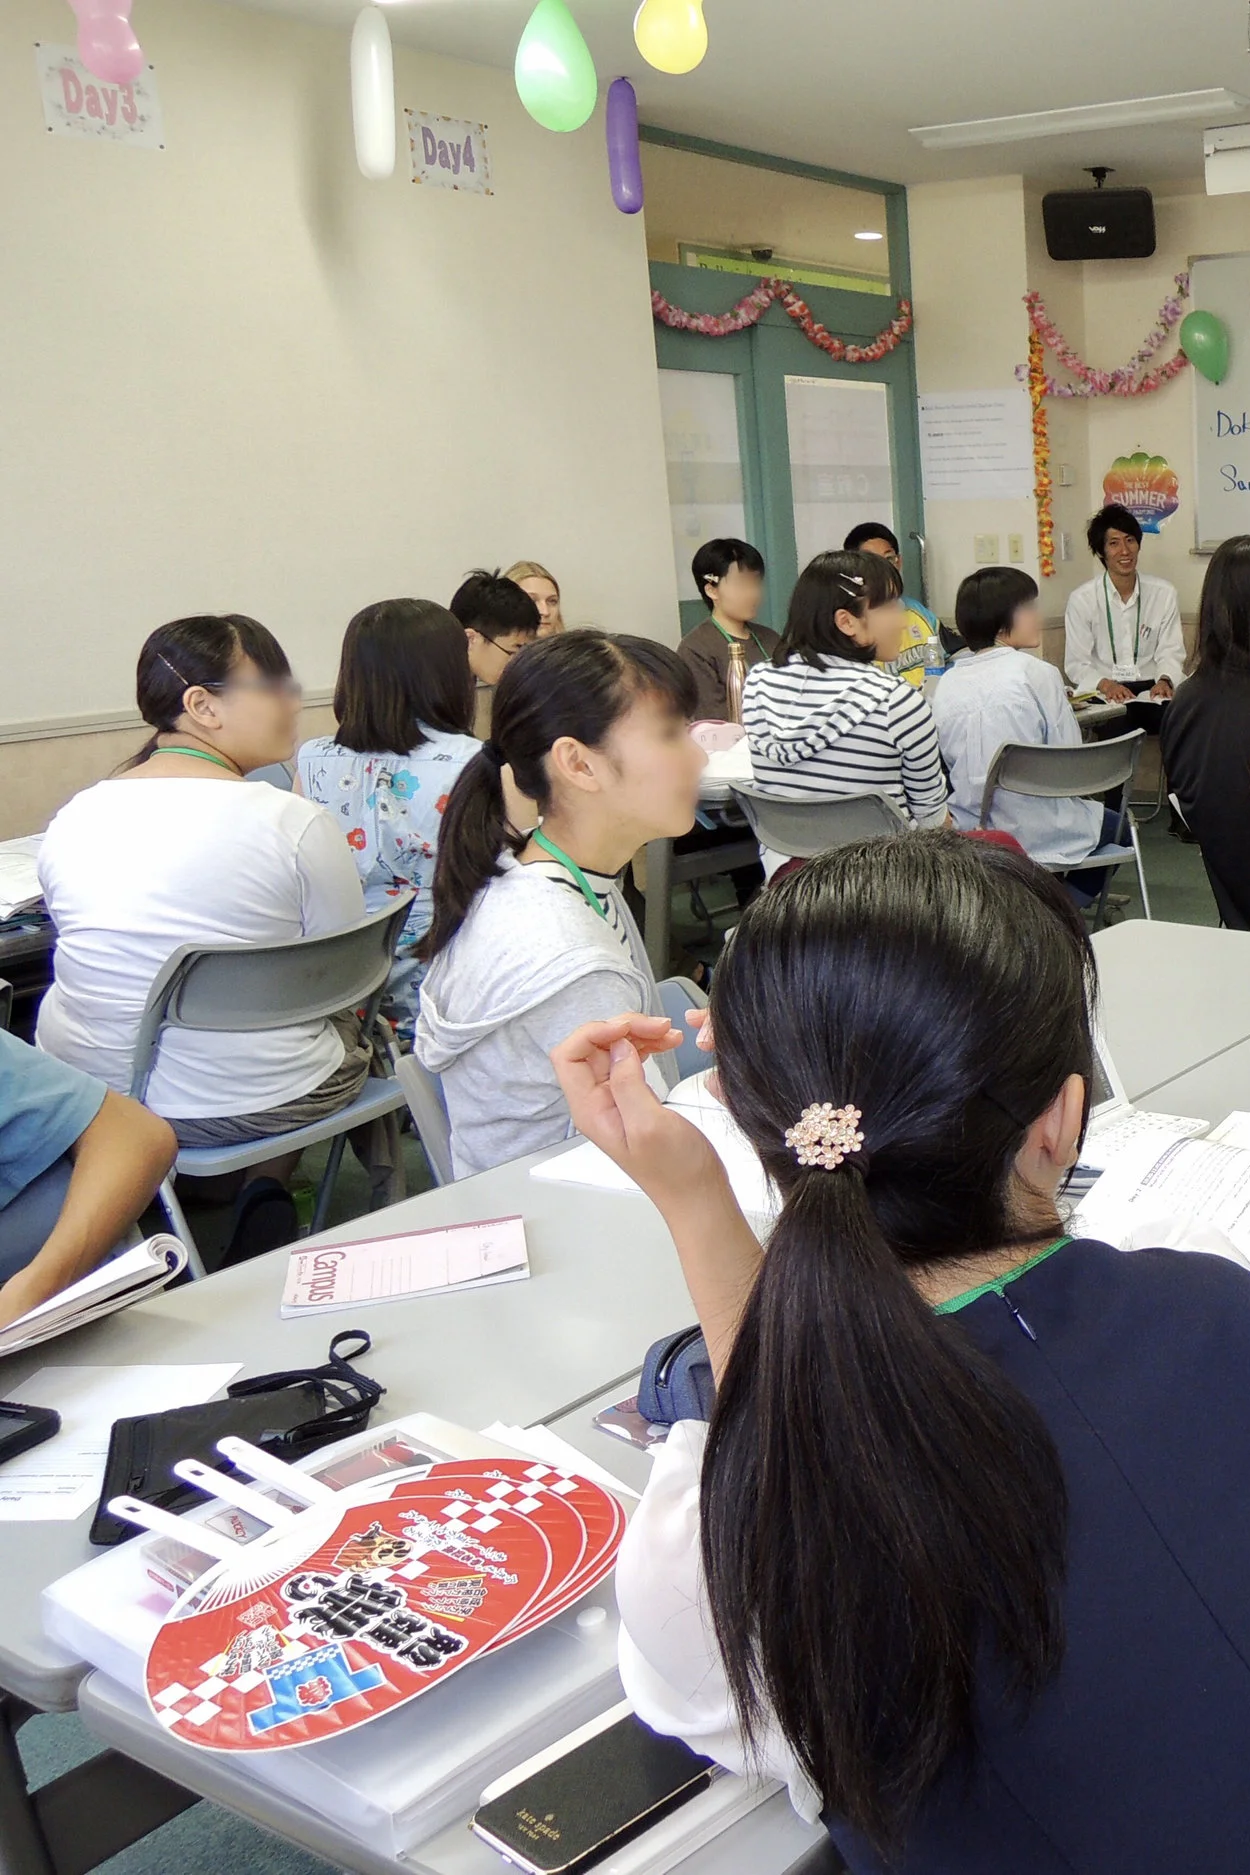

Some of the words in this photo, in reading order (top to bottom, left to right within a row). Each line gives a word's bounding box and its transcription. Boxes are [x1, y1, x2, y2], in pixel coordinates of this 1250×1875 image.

[61, 67, 138, 126] Day3
[422, 126, 475, 175] Day4
[1111, 490, 1168, 509] SUMMER
[302, 1251, 346, 1302] Campus
[516, 1808, 537, 1824] kate
[534, 1822, 560, 1840] spade
